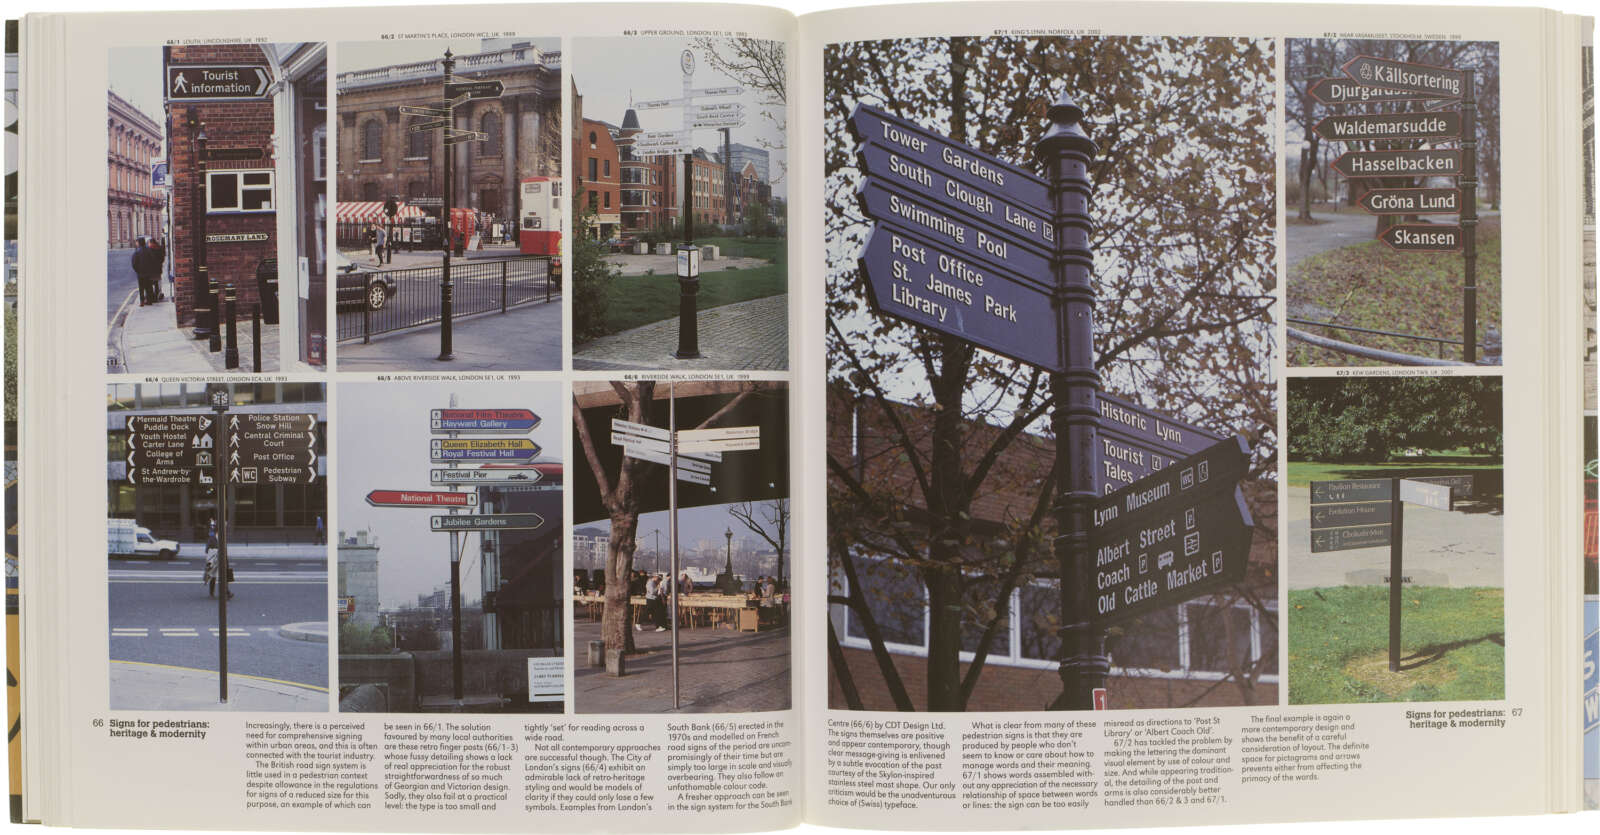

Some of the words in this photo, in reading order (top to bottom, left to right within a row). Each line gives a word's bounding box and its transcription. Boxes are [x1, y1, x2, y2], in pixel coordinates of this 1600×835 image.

[202, 71, 239, 80] Tourist
[1374, 65, 1460, 94] Källsortering
[191, 82, 250, 93] information
[1333, 118, 1446, 136] Waldemarsudde
[880, 121, 928, 153] Tower
[942, 147, 1004, 186] Gardens
[1352, 156, 1453, 172] Hasselbacken
[889, 154, 932, 187] South
[946, 180, 993, 214] Clough
[1005, 206, 1037, 233] Lane
[1370, 194, 1414, 209] Gröna
[1420, 194, 1455, 208] Lund
[890, 195, 965, 244] Swimming
[977, 232, 1007, 260] Pool
[1394, 230, 1454, 245] Skansen
[891, 236, 926, 265] Post
[939, 255, 984, 287] Office
[893, 260, 912, 283] St.
[927, 274, 972, 306] James
[985, 296, 1017, 323] Park
[892, 284, 947, 323] Library
[481, 420, 507, 428] Gallery
[1100, 400, 1147, 431] Historic
[1156, 420, 1182, 443] Lynn
[1103, 439, 1144, 466] Tourist
[244, 470, 256, 480] WC
[1104, 460, 1133, 483] Tales
[401, 494, 432, 502] National
[1094, 505, 1118, 526] Lynn
[1126, 481, 1170, 512] Museum
[443, 518, 471, 526] Jubilee
[474, 518, 506, 526] Gardens
[1096, 539, 1130, 567] Albert
[1139, 520, 1176, 548] Street
[1098, 563, 1130, 590] Coach
[1098, 592, 1115, 614] Old
[1125, 580, 1157, 605] Cattle
[1167, 560, 1207, 590] Market
[1405, 710, 1431, 720] Signs
[1433, 709, 1446, 718] for
[1448, 709, 1506, 719] pedestrians:
[1512, 708, 1523, 716] 67
[93, 719, 104, 727] 66
[110, 719, 135, 728] Signs
[138, 719, 150, 727] for
[152, 720, 210, 729] pedestrians:
[246, 721, 291, 731] Increasingly,
[329, 722, 364, 731] perceived
[828, 719, 849, 728] Centre
[874, 720, 883, 730] by
[902, 721, 929, 731] Design
[1409, 720, 1447, 729] heritage
[1458, 719, 1506, 728] modernity
[110, 729, 148, 739] heritage
[159, 729, 206, 739] modernity
[962, 731, 1003, 741] pedestrian
[1004, 731, 1024, 740] signs
[1052, 731, 1068, 741] they
[562, 744, 614, 753] contemporary
[616, 744, 661, 754] approaches
[1104, 748, 1131, 758] making
[1147, 747, 1177, 758] lettering
[1179, 747, 1190, 755] the
[1192, 746, 1226, 755] dominant
[270, 760, 294, 768] British
[315, 761, 330, 771] sign
[332, 761, 358, 771] system
[1241, 773, 1271, 784] primacy
[1281, 773, 1293, 781] the
[667, 783, 721, 791] unfathomable
